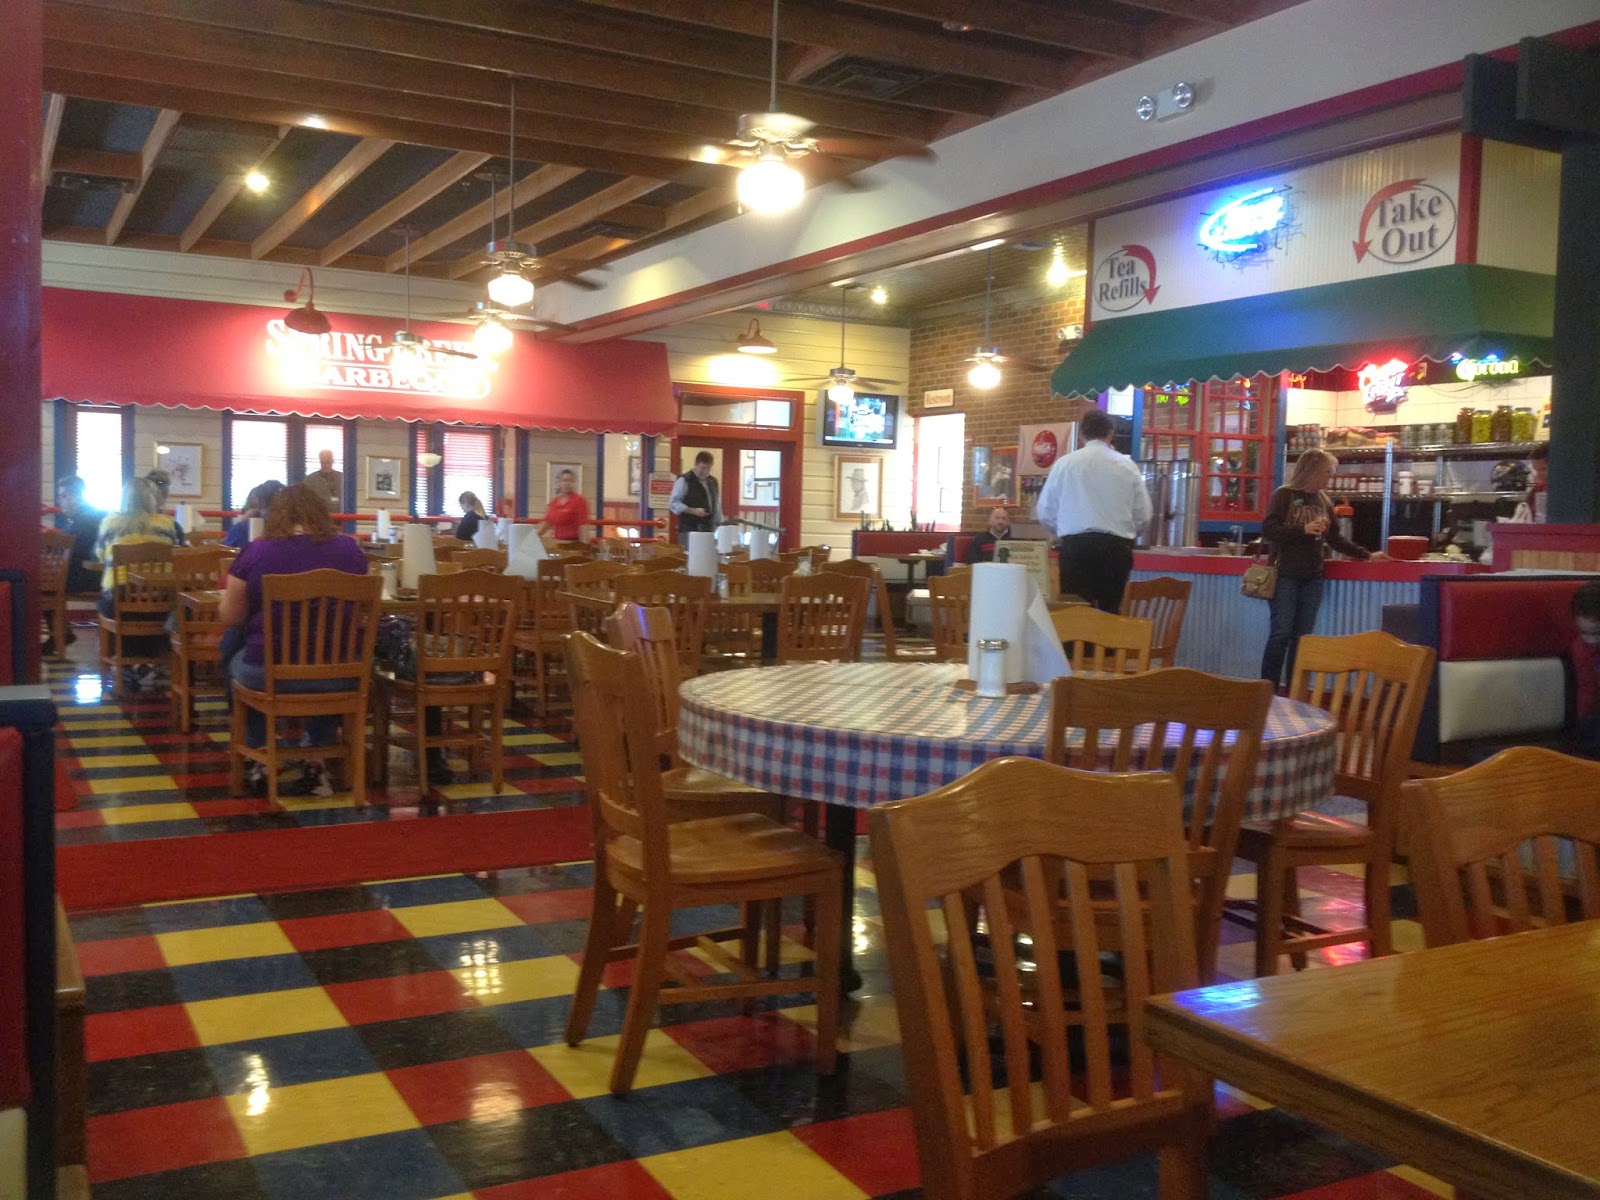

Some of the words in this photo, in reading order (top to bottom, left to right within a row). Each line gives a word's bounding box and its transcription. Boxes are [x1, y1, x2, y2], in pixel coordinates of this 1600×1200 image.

[1376, 192, 1443, 229] Take
[1382, 222, 1440, 257] Out
[1106, 256, 1136, 278] Tea
[1098, 274, 1147, 304] Refills
[1456, 357, 1519, 382] Corona
